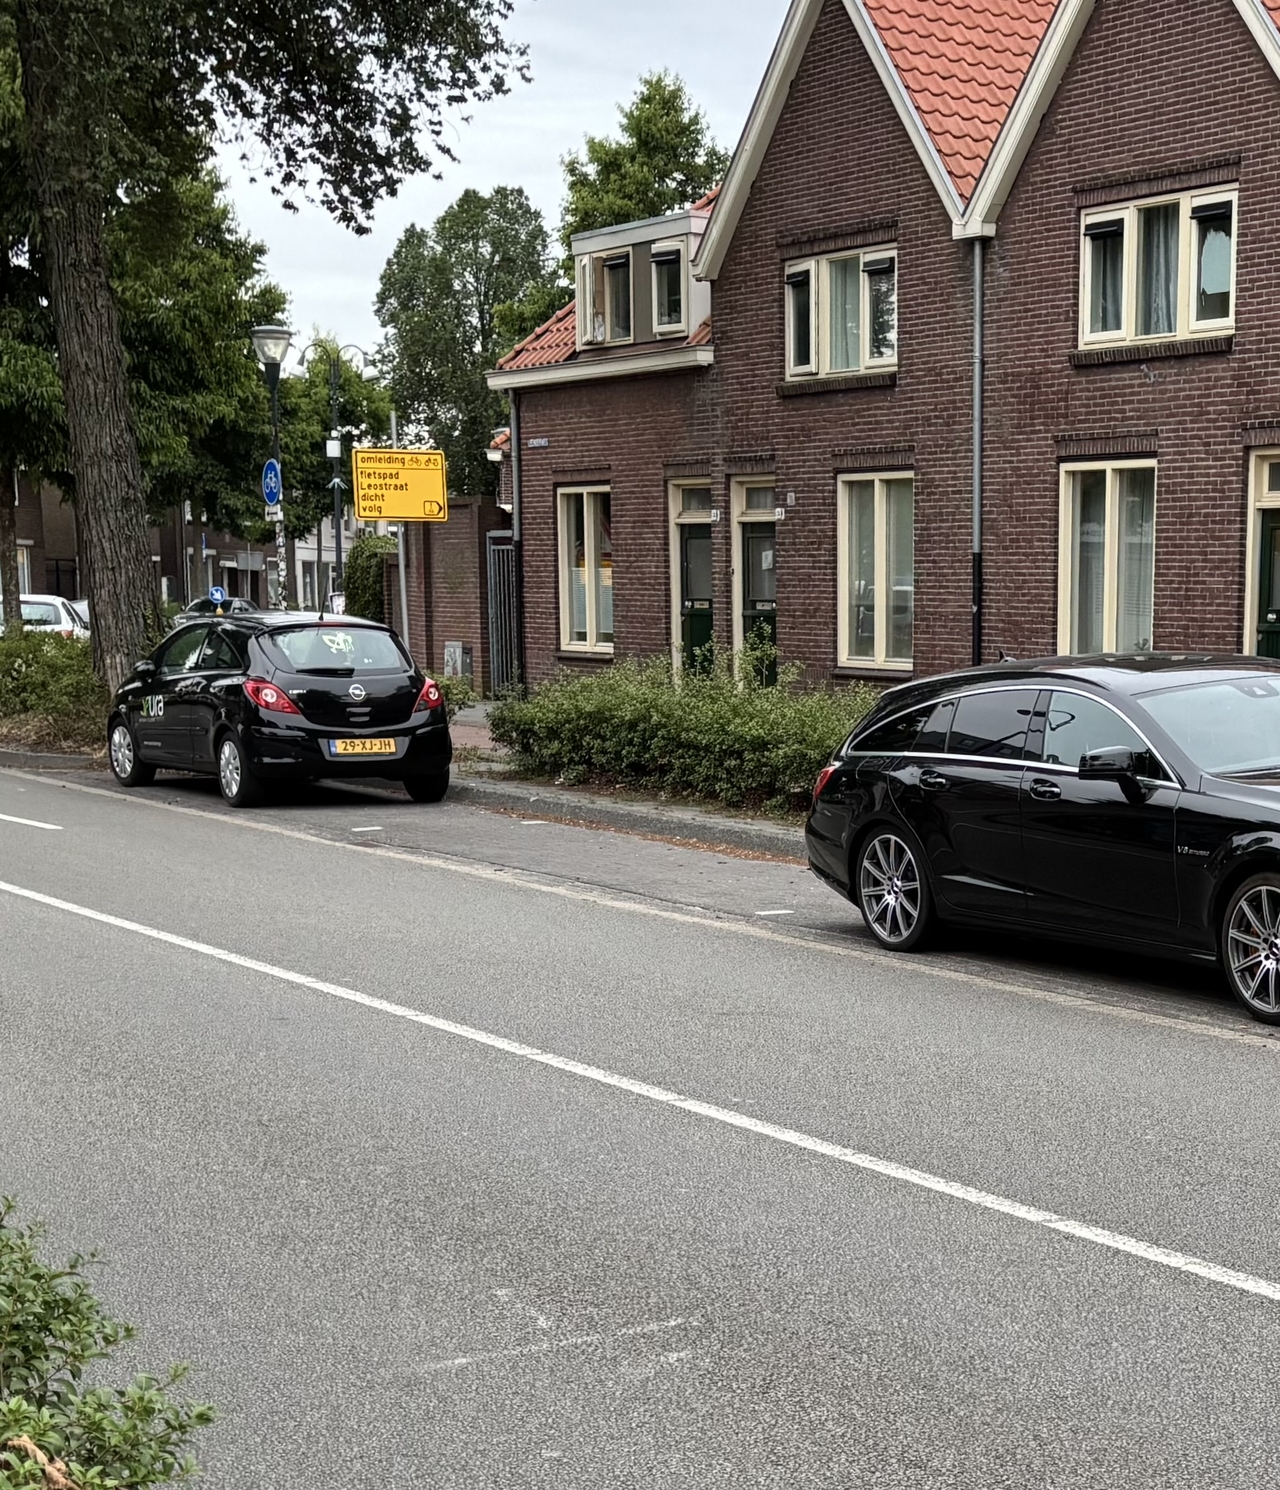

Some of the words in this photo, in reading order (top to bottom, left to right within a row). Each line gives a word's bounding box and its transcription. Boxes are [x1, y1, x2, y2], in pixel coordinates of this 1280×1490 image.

[360, 455, 406, 467] omleiding
[360, 470, 400, 481] fietspad
[360, 481, 409, 491] Leostraat
[360, 492, 385, 502] dicht
[361, 504, 382, 516] volg
[341, 740, 391, 751] 29-XJ-JH
